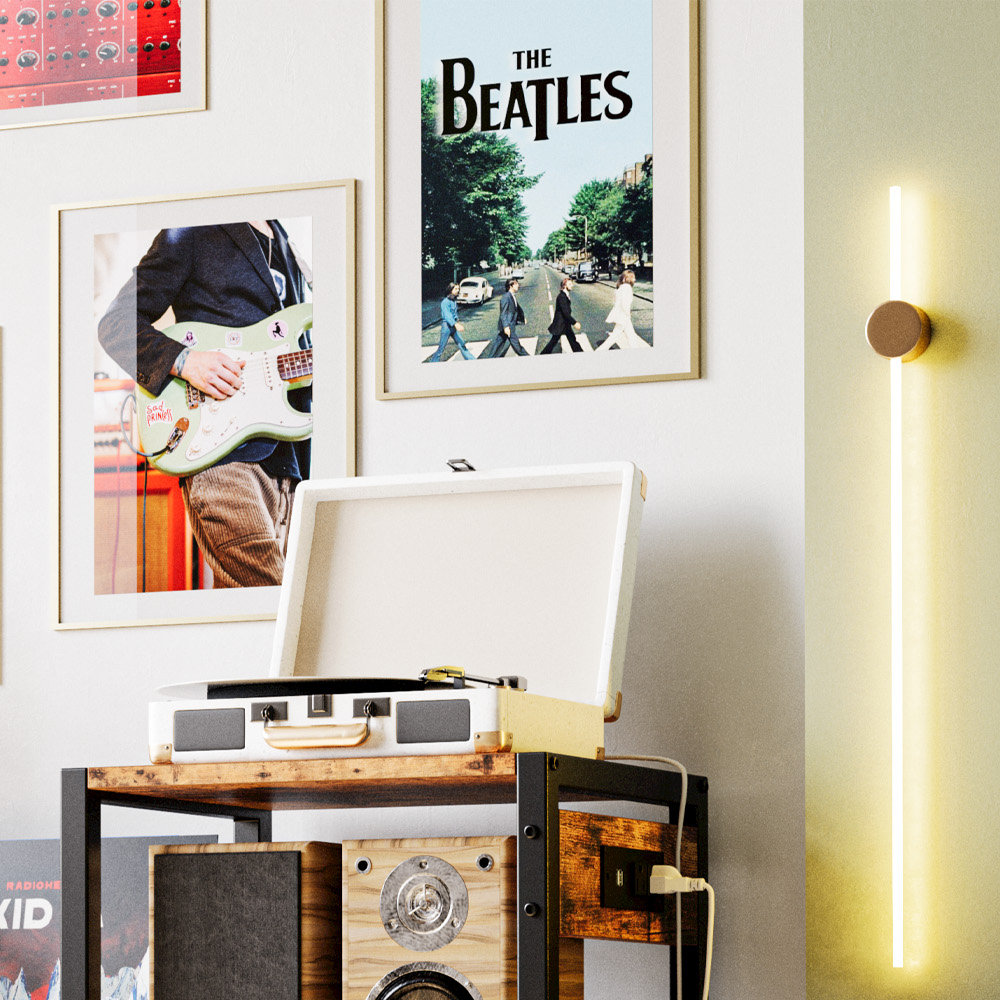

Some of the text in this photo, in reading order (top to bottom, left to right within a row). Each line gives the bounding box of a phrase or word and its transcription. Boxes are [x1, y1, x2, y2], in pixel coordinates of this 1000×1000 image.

[512, 47, 552, 71] THE
[440, 56, 633, 141] BEATLES
[6, 880, 61, 891] RADIOHE
